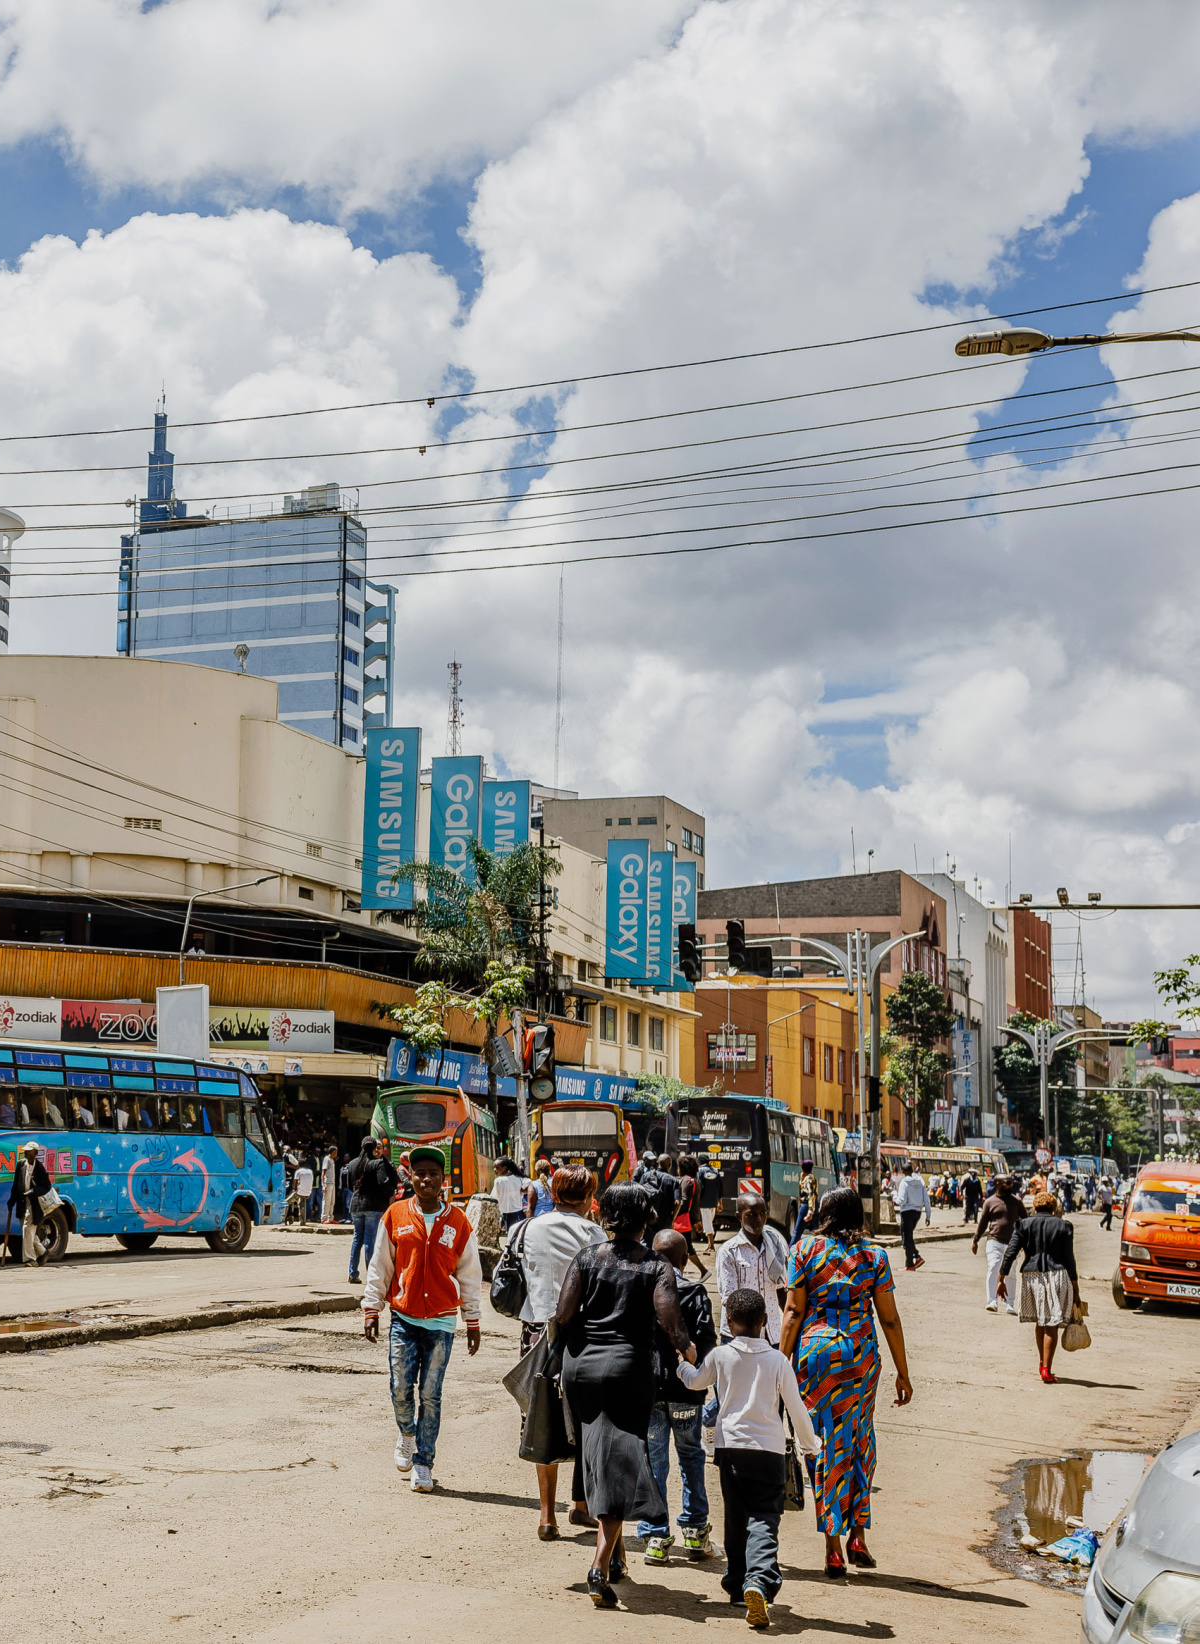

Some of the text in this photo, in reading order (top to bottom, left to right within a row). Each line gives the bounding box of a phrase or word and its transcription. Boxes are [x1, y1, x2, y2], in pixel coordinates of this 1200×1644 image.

[375, 739, 405, 898] SAMSUNG
[443, 773, 475, 876] Galax
[610, 853, 644, 965] Galaxy
[15, 1010, 58, 1024] zodiak
[291, 1022, 332, 1034] zodiak
[556, 1075, 586, 1097] AMSUNG
[702, 1110, 728, 1121] Springs
[702, 1121, 727, 1132] Shuttle
[1168, 1285, 1186, 1295] KAR
